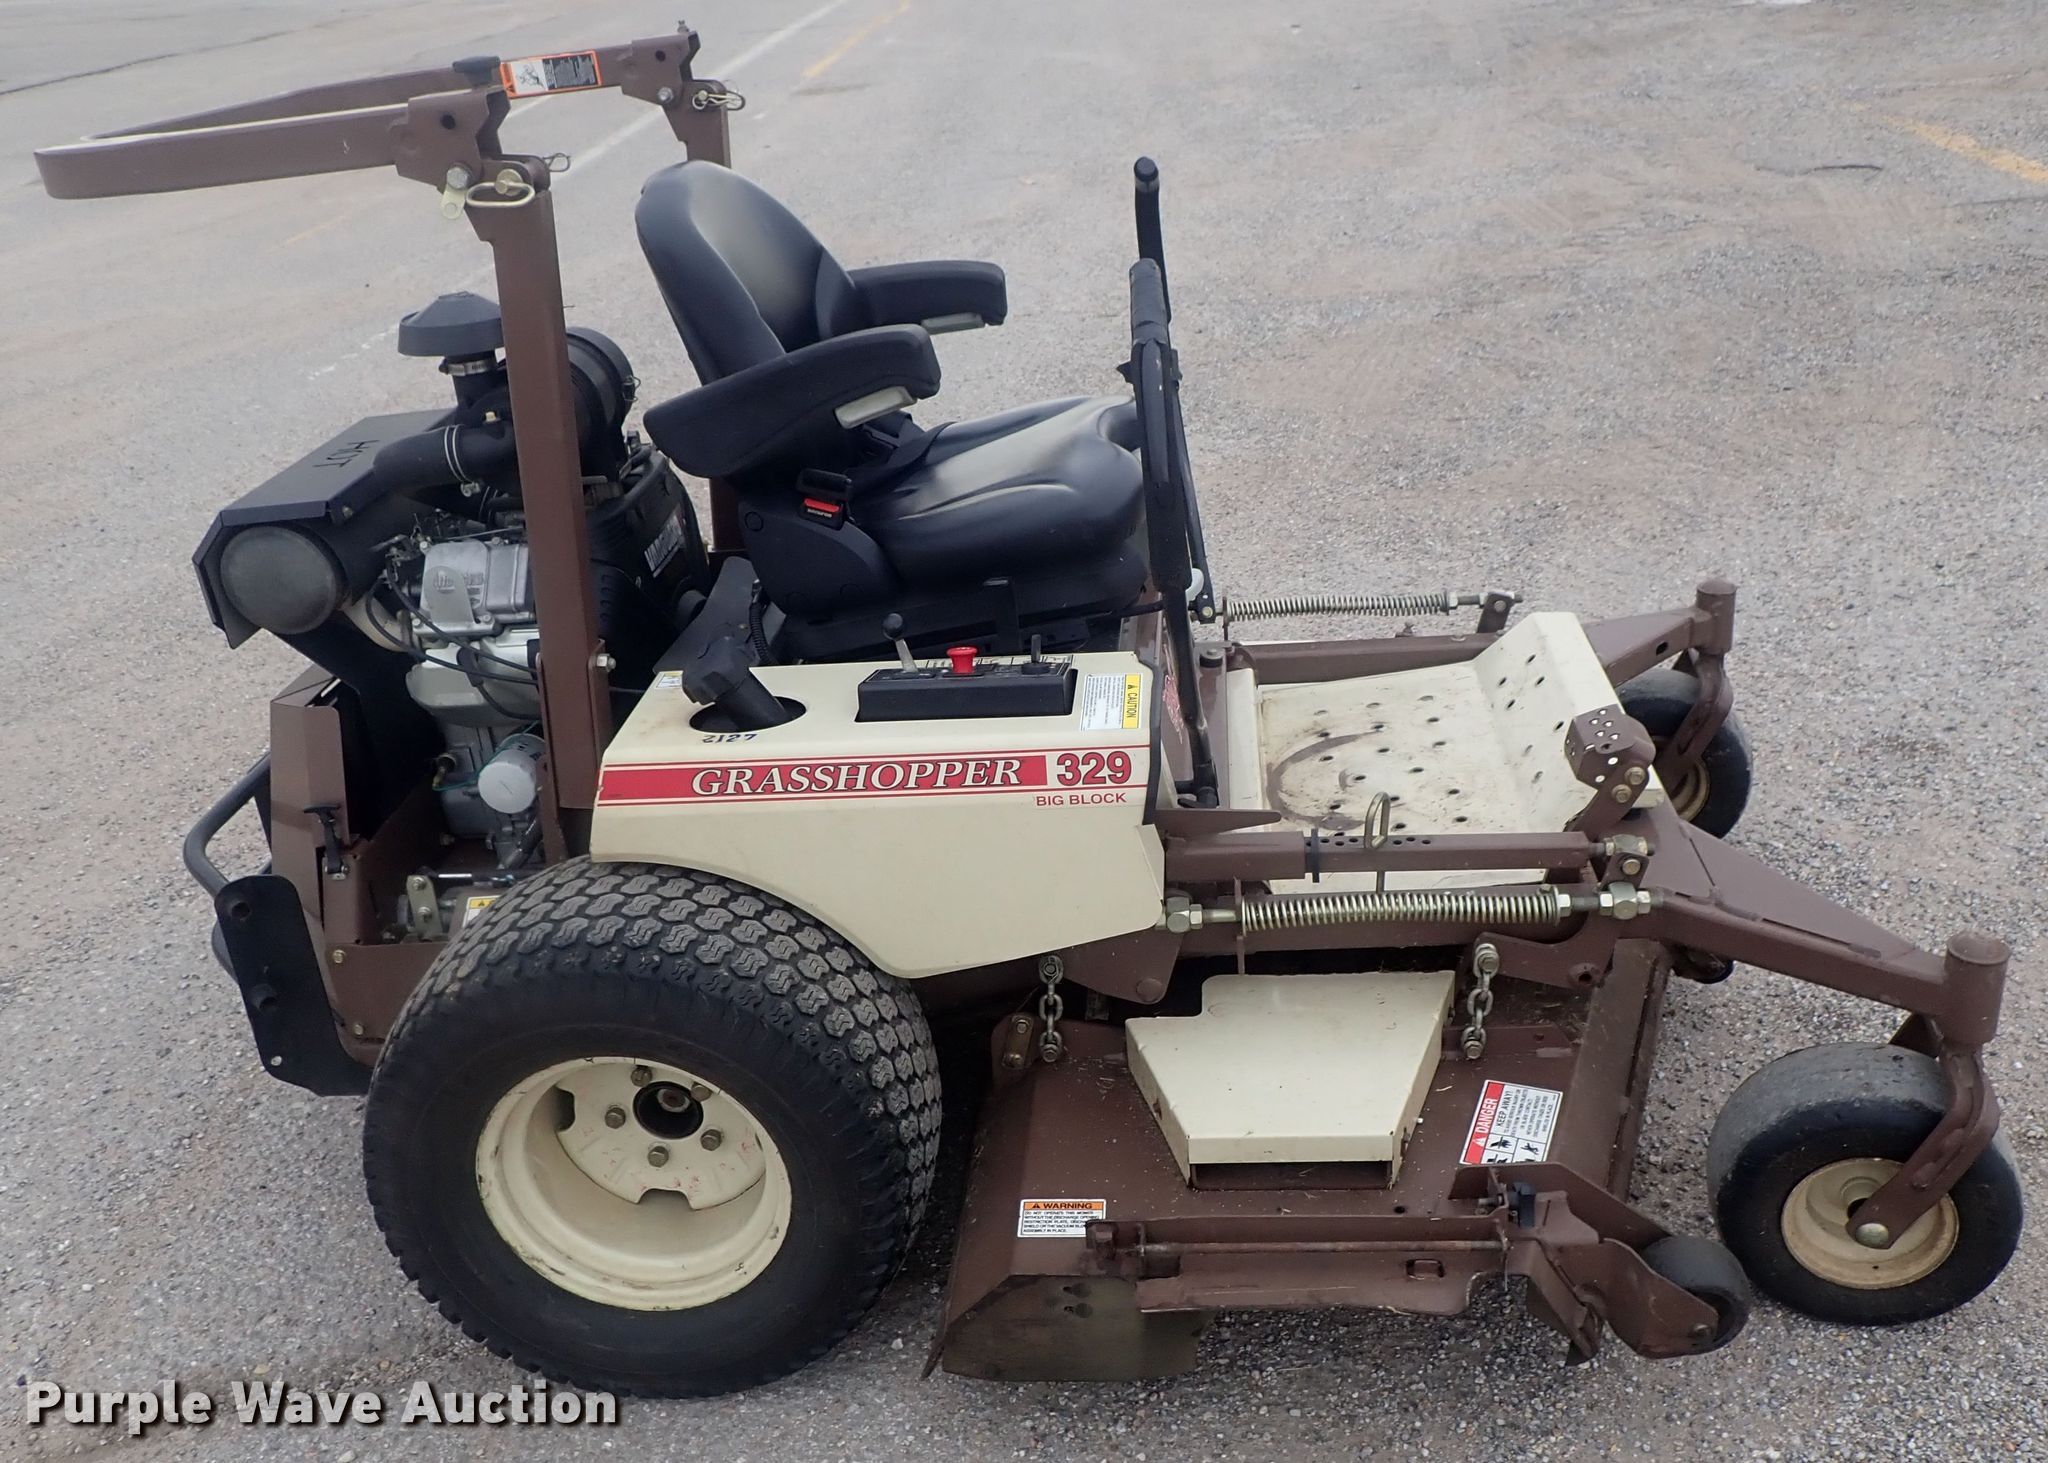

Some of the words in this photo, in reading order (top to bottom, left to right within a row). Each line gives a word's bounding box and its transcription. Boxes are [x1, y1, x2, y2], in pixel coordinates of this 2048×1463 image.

[1126, 692, 1138, 718] CAUTION
[702, 733, 758, 743] 2127
[691, 758, 1021, 796] GRASSHOPPER
[1056, 750, 1132, 787] 329
[1036, 795, 1064, 806] BIG
[1069, 792, 1127, 805] BLOCK
[1475, 1098, 1498, 1133] DANGER
